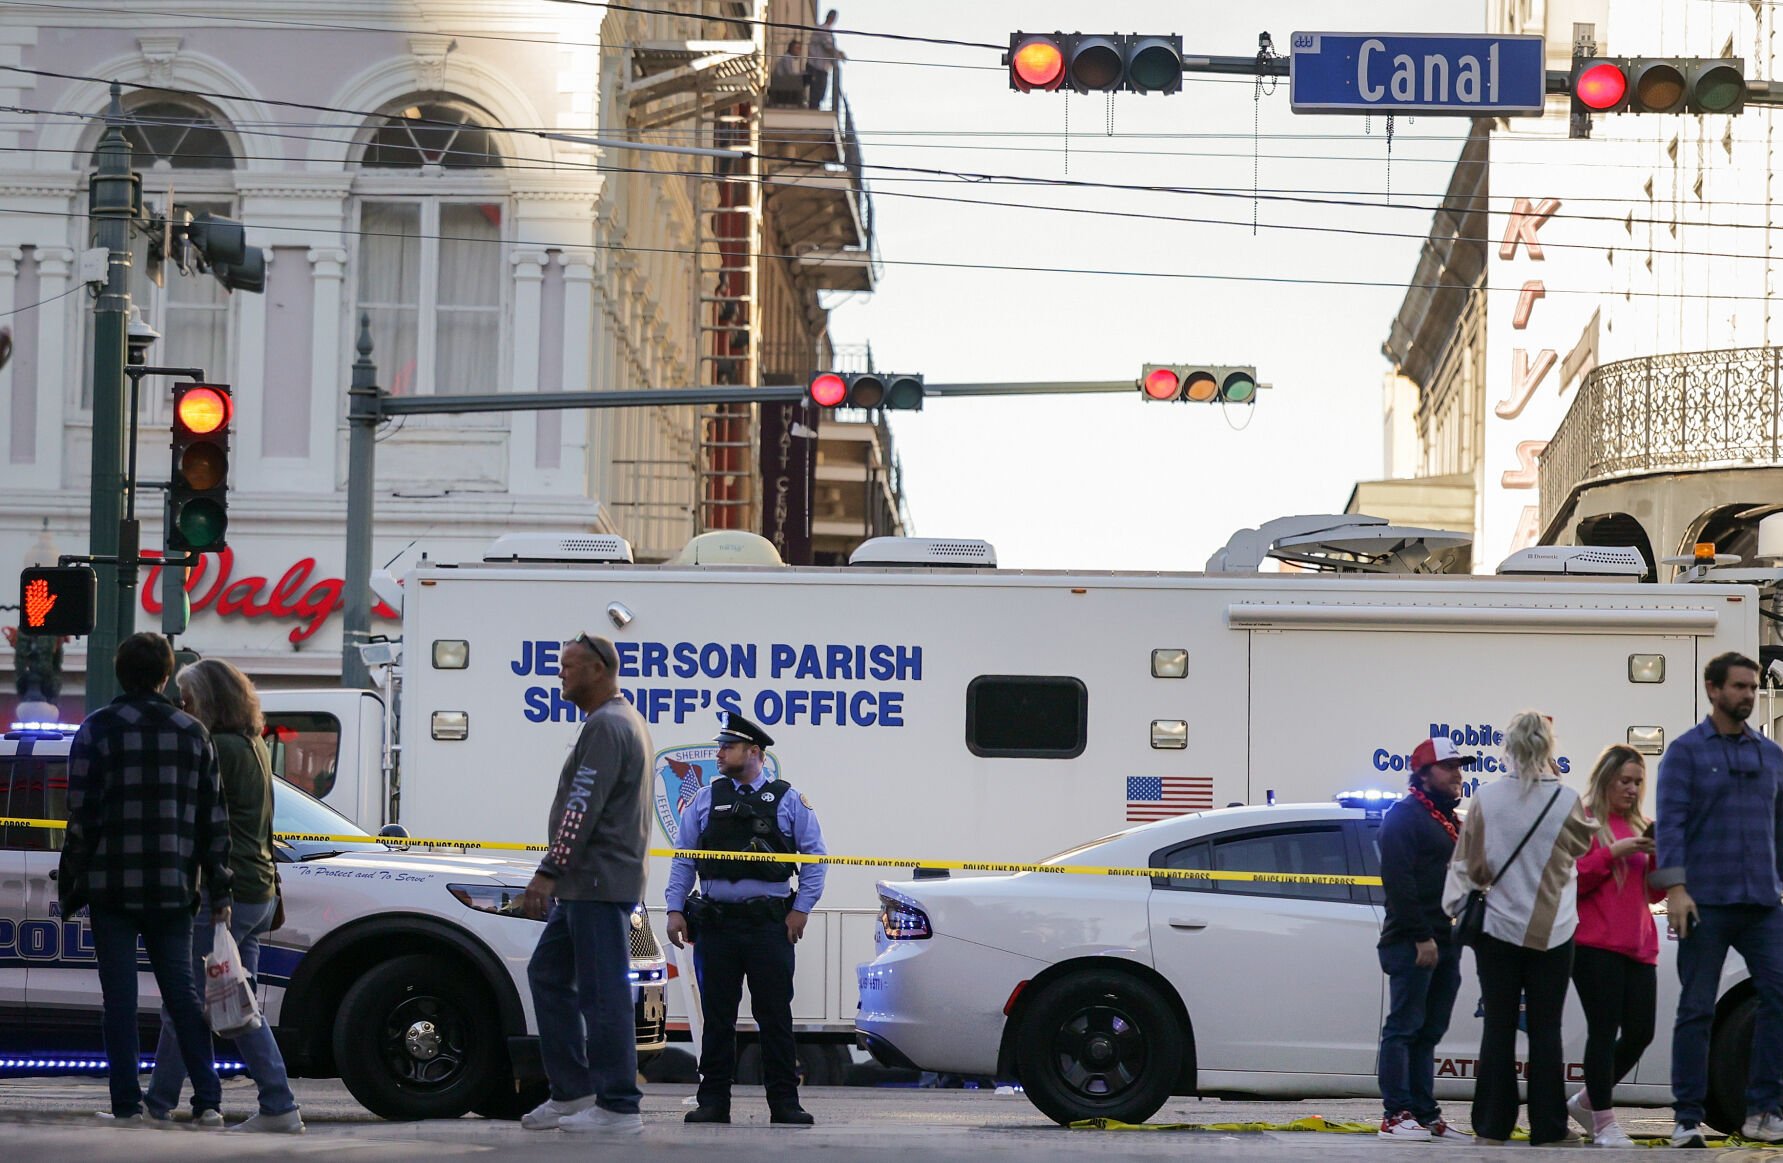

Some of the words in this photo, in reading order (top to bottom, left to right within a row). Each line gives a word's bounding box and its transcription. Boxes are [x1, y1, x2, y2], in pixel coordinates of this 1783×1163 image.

[1357, 39, 1499, 102] Canal
[139, 545, 400, 643] Walg
[511, 640, 757, 679] JEERSON
[771, 644, 923, 681] PARISH
[754, 689, 905, 727] OFFICE
[1430, 723, 1503, 746] Mobile
[676, 749, 719, 761] SHERIFF'
[315, 867, 351, 878] Protect
[355, 871, 375, 879] and
[379, 871, 391, 880] To
